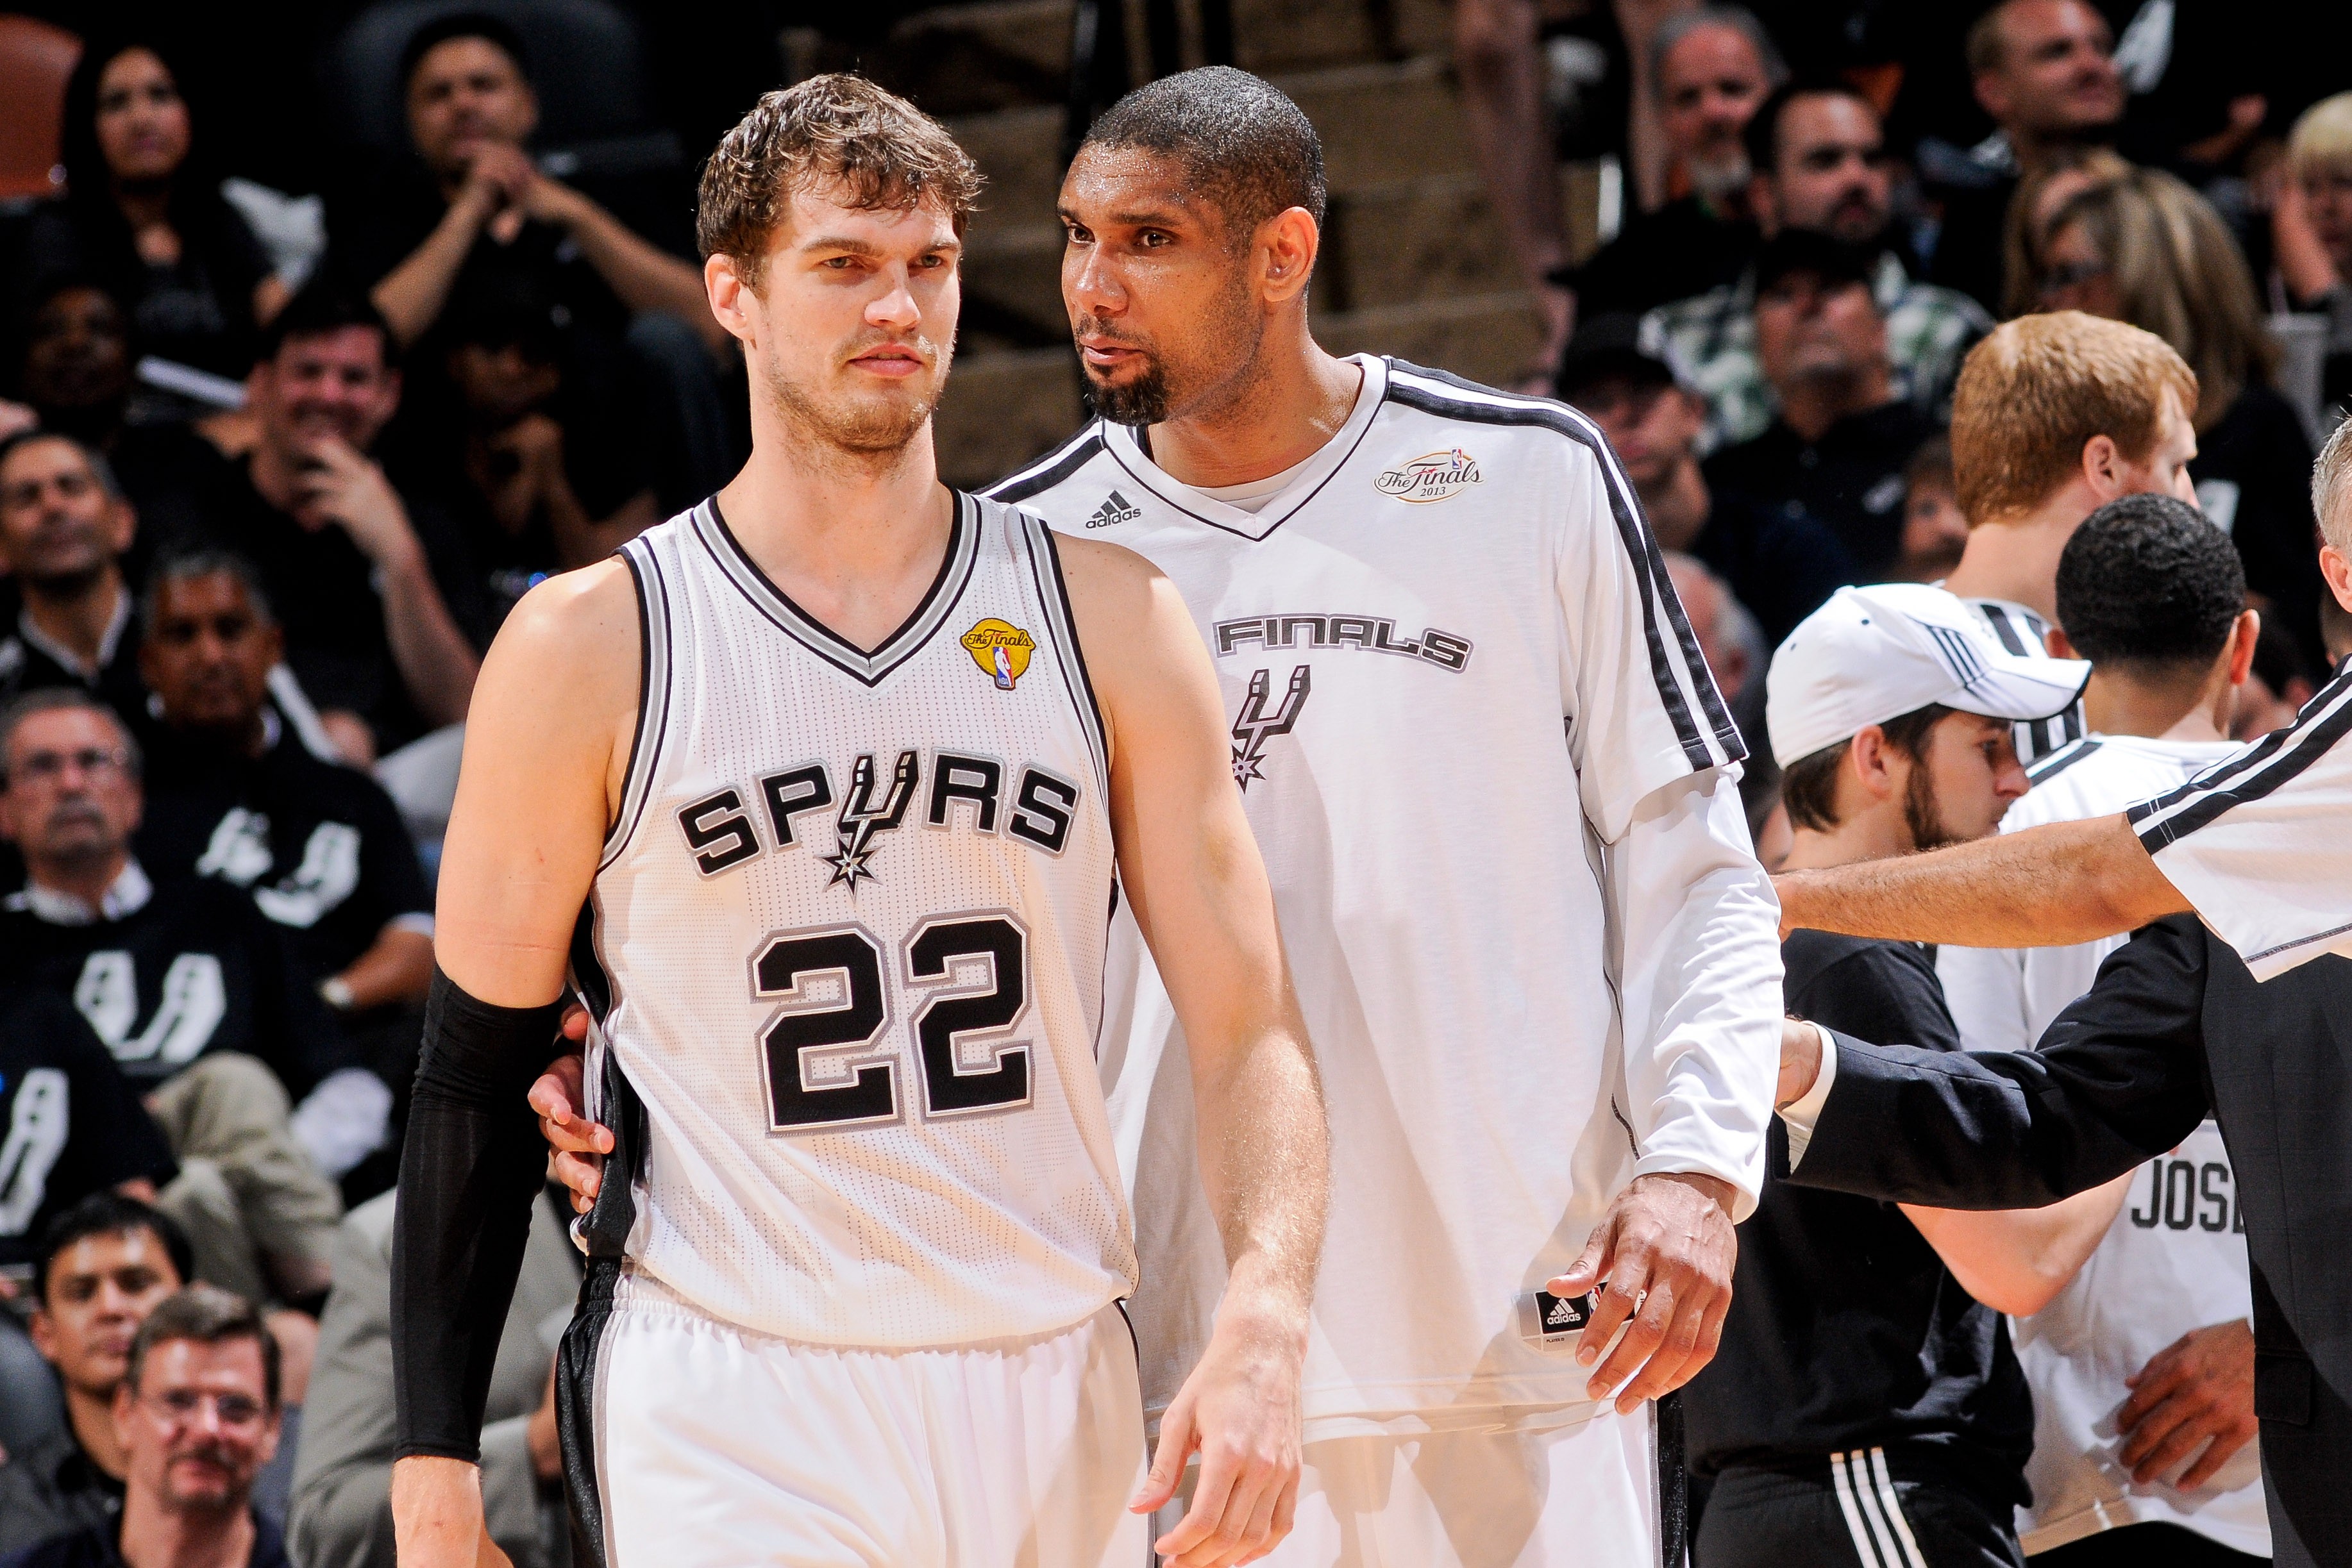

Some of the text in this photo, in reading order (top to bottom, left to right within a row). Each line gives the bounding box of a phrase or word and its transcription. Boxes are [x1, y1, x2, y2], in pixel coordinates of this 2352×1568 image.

[1378, 461, 1484, 491] The Finals
[1419, 486, 1447, 497] 2013
[1085, 508, 1141, 529] adidas
[966, 628, 1032, 647] The Finals
[1212, 613, 1474, 674] FINALS
[672, 746, 1082, 906] SPURS
[746, 907, 1036, 1138] 22
[1547, 1313, 1581, 1325] adidas
